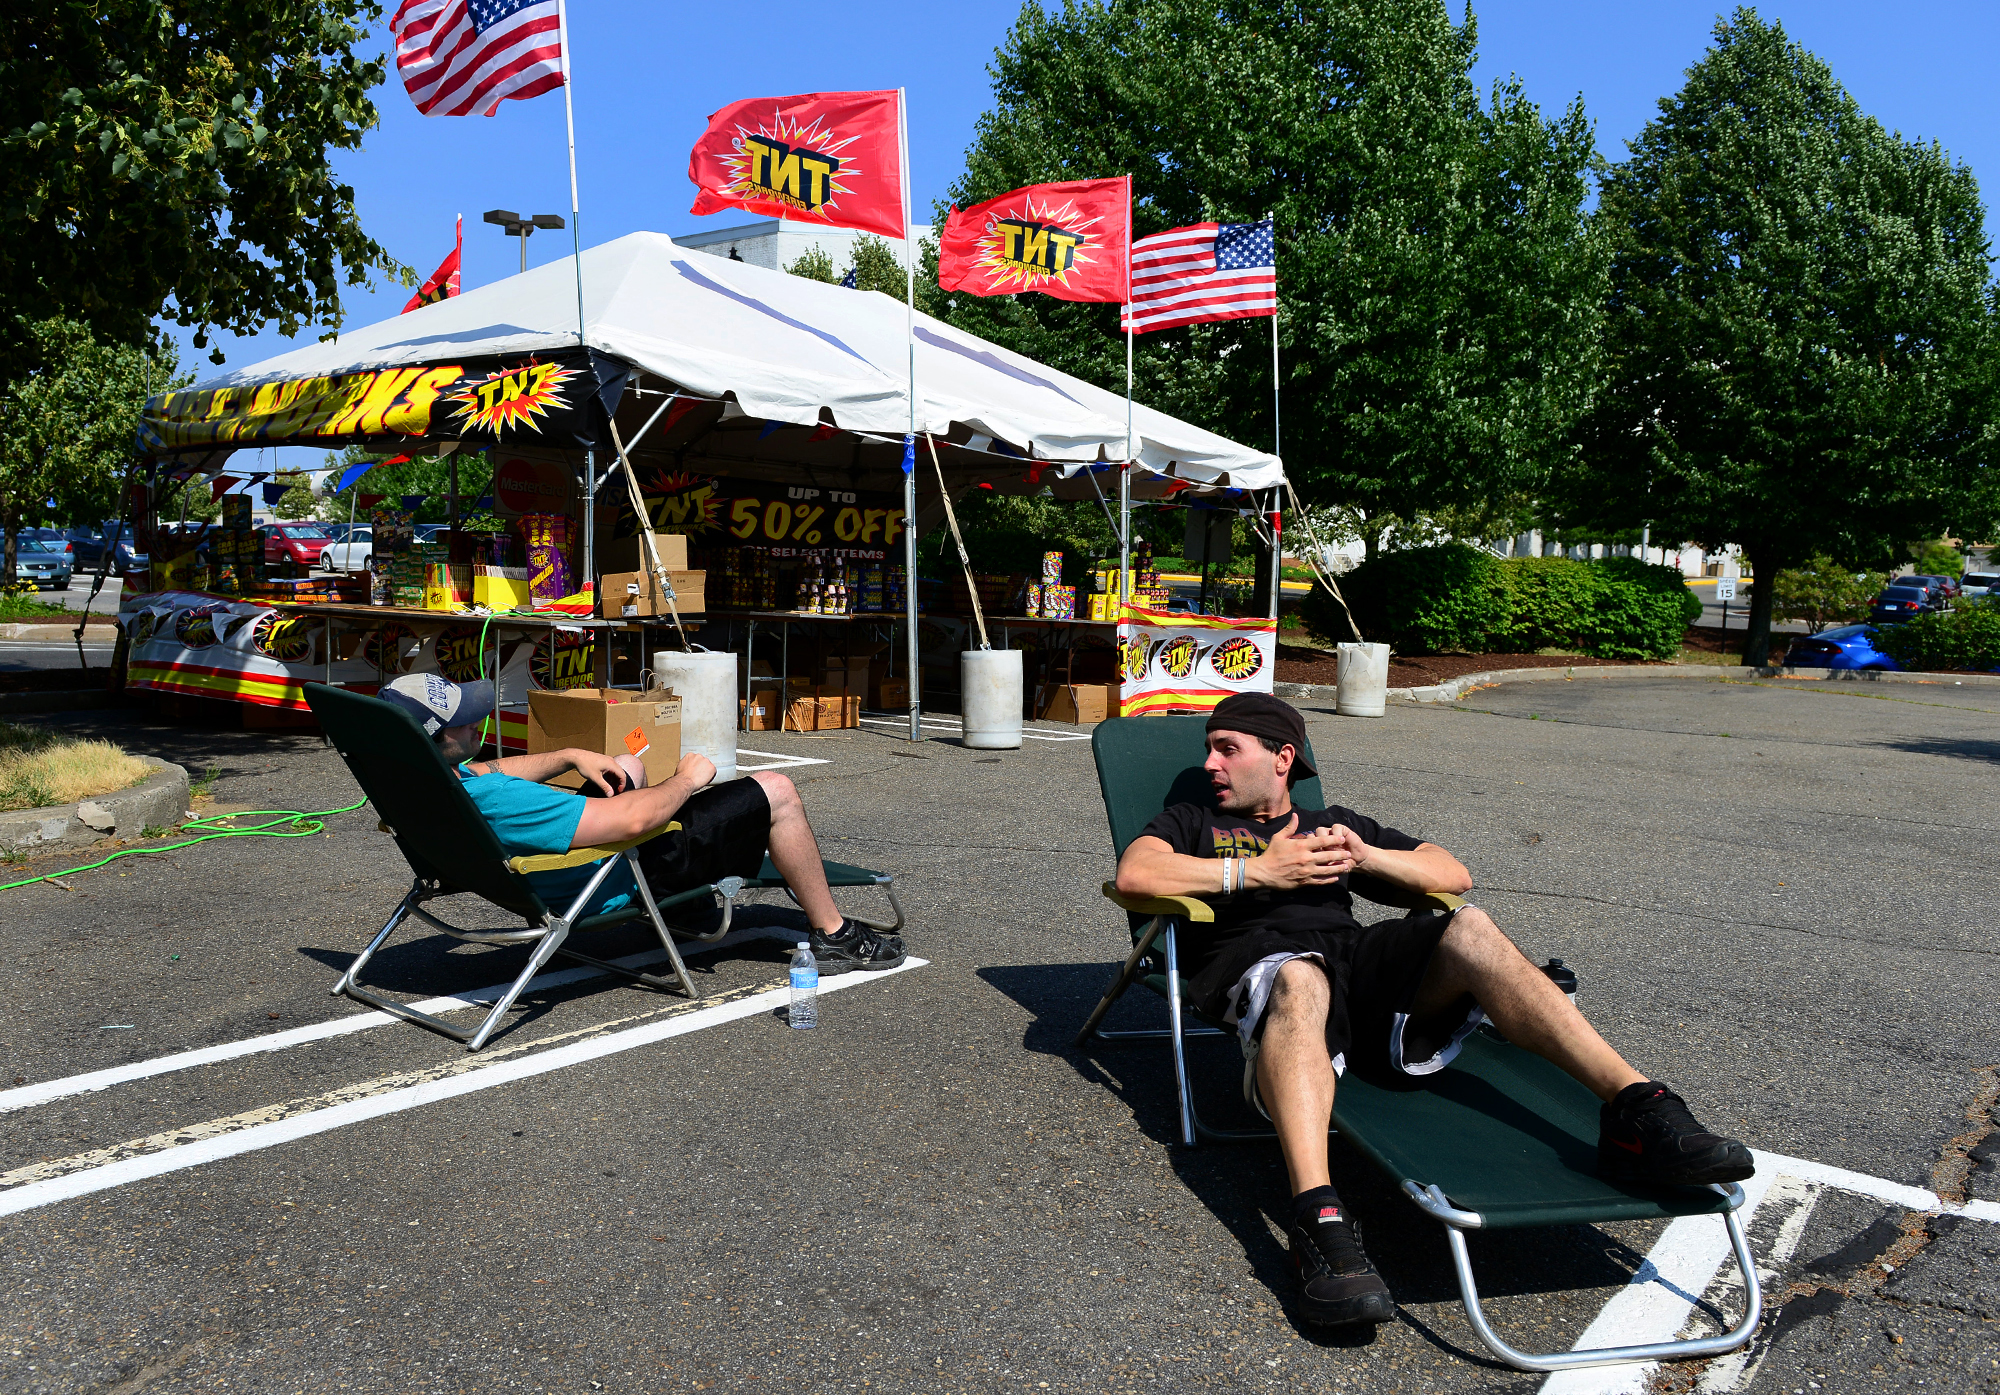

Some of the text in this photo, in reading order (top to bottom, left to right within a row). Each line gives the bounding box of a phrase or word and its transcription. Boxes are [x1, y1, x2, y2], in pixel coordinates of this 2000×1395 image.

[142, 361, 555, 449] FIREWORKS TNT
[499, 476, 565, 498] MasterCard
[787, 487, 858, 504] UP TO
[635, 485, 712, 529] TNT
[729, 497, 905, 546] 50% OFF
[533, 554, 547, 564] TNT
[771, 547, 831, 558] SELECT
[834, 548, 887, 560] ITEMS
[1720, 589, 1733, 598] 15
[1170, 642, 1193, 667] TNT
[1225, 645, 1253, 668] TNT
[1319, 1207, 1338, 1217] NIKE
